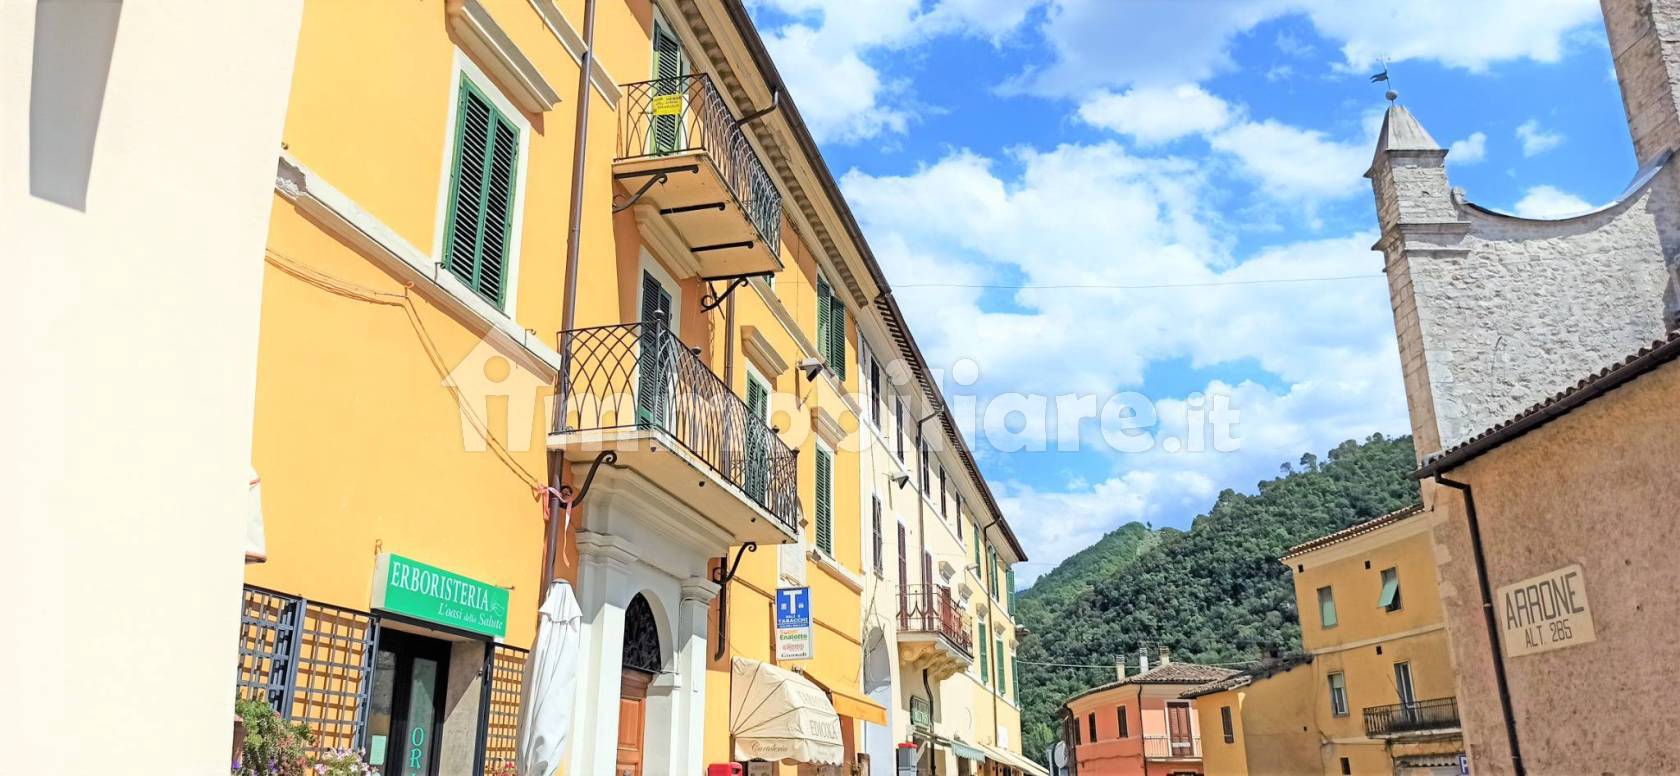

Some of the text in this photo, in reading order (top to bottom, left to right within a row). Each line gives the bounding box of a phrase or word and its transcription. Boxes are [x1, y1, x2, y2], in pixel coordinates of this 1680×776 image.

[391, 561, 489, 612] ERBORISTERIA
[1506, 571, 1584, 630] ARRONE
[438, 602, 463, 620] L'oasi
[479, 613, 503, 630] Salute
[783, 590, 803, 614] T
[1549, 618, 1573, 642] 285
